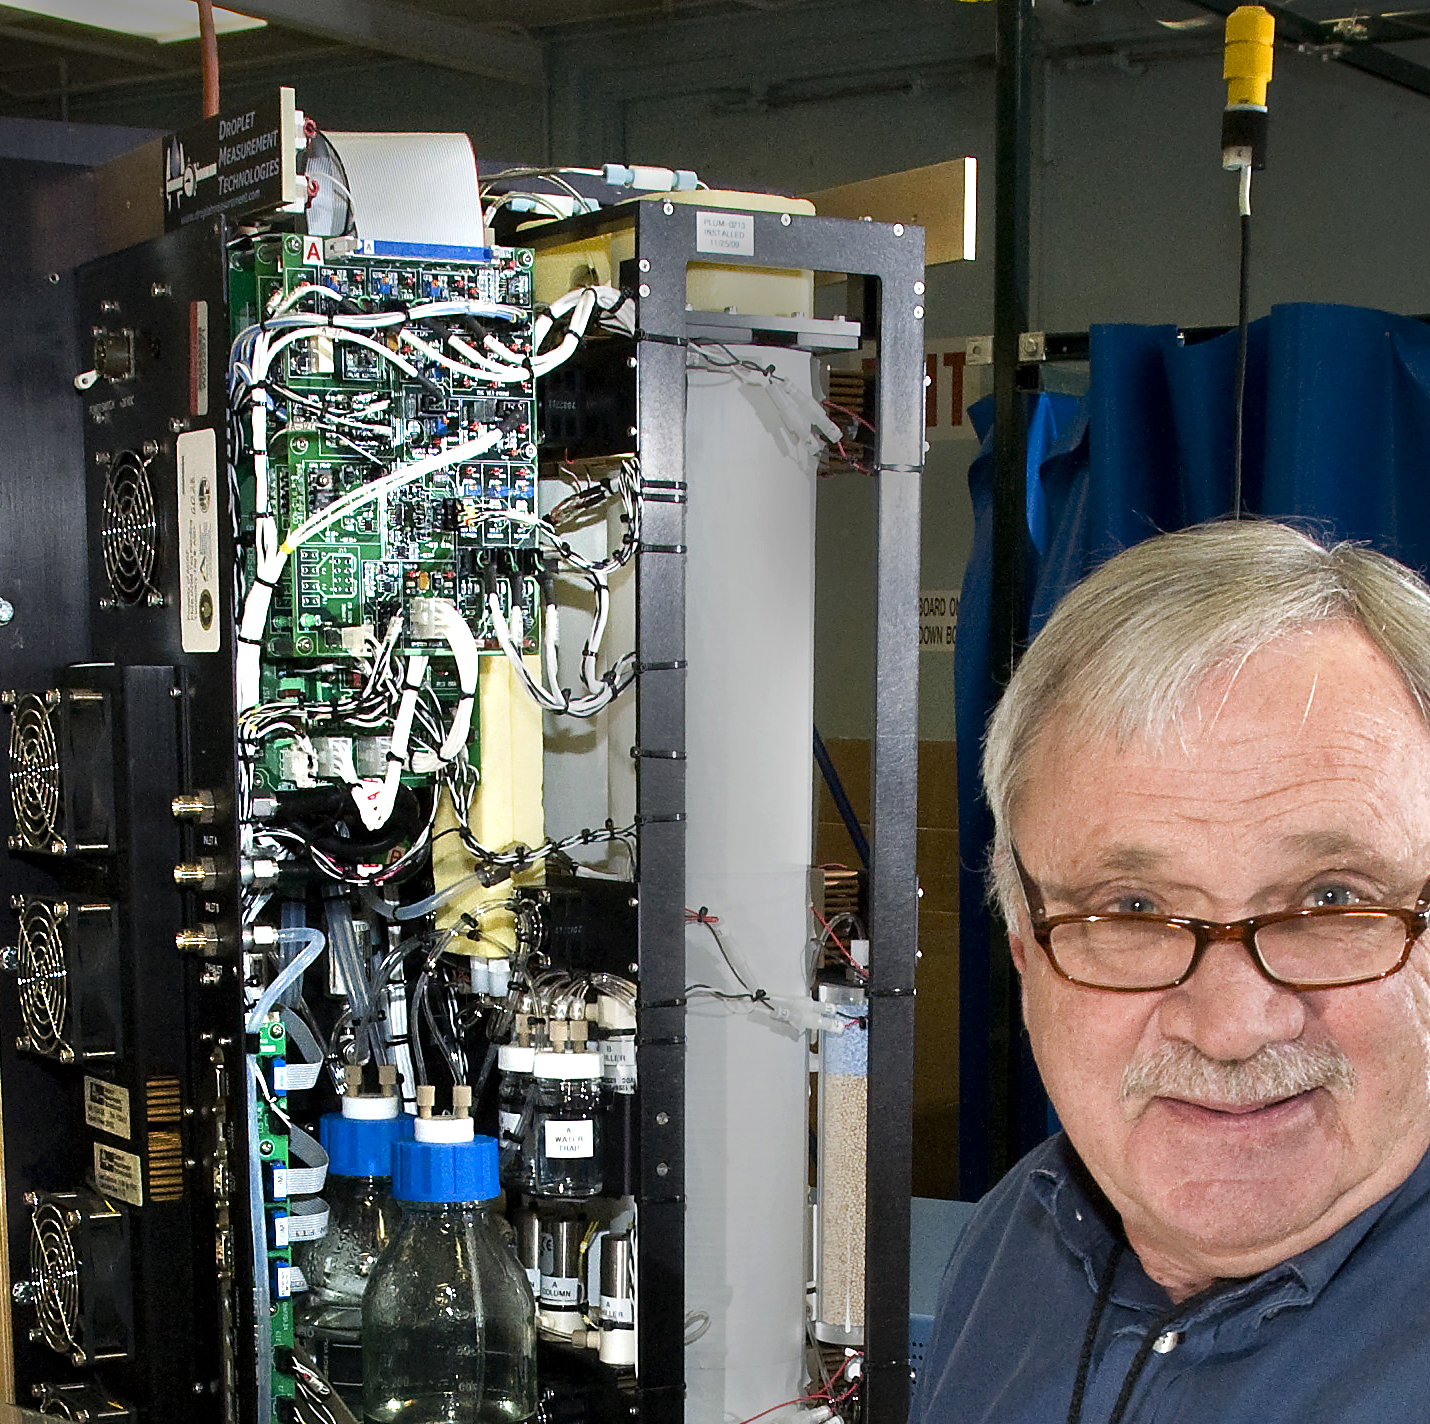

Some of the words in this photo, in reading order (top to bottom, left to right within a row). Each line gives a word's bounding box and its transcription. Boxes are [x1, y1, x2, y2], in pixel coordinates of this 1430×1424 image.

[219, 111, 255, 141] DROPLET
[218, 130, 278, 168] MEASUREMENT
[218, 158, 279, 196] TECHNOLOGIES
[306, 243, 321, 261] A
